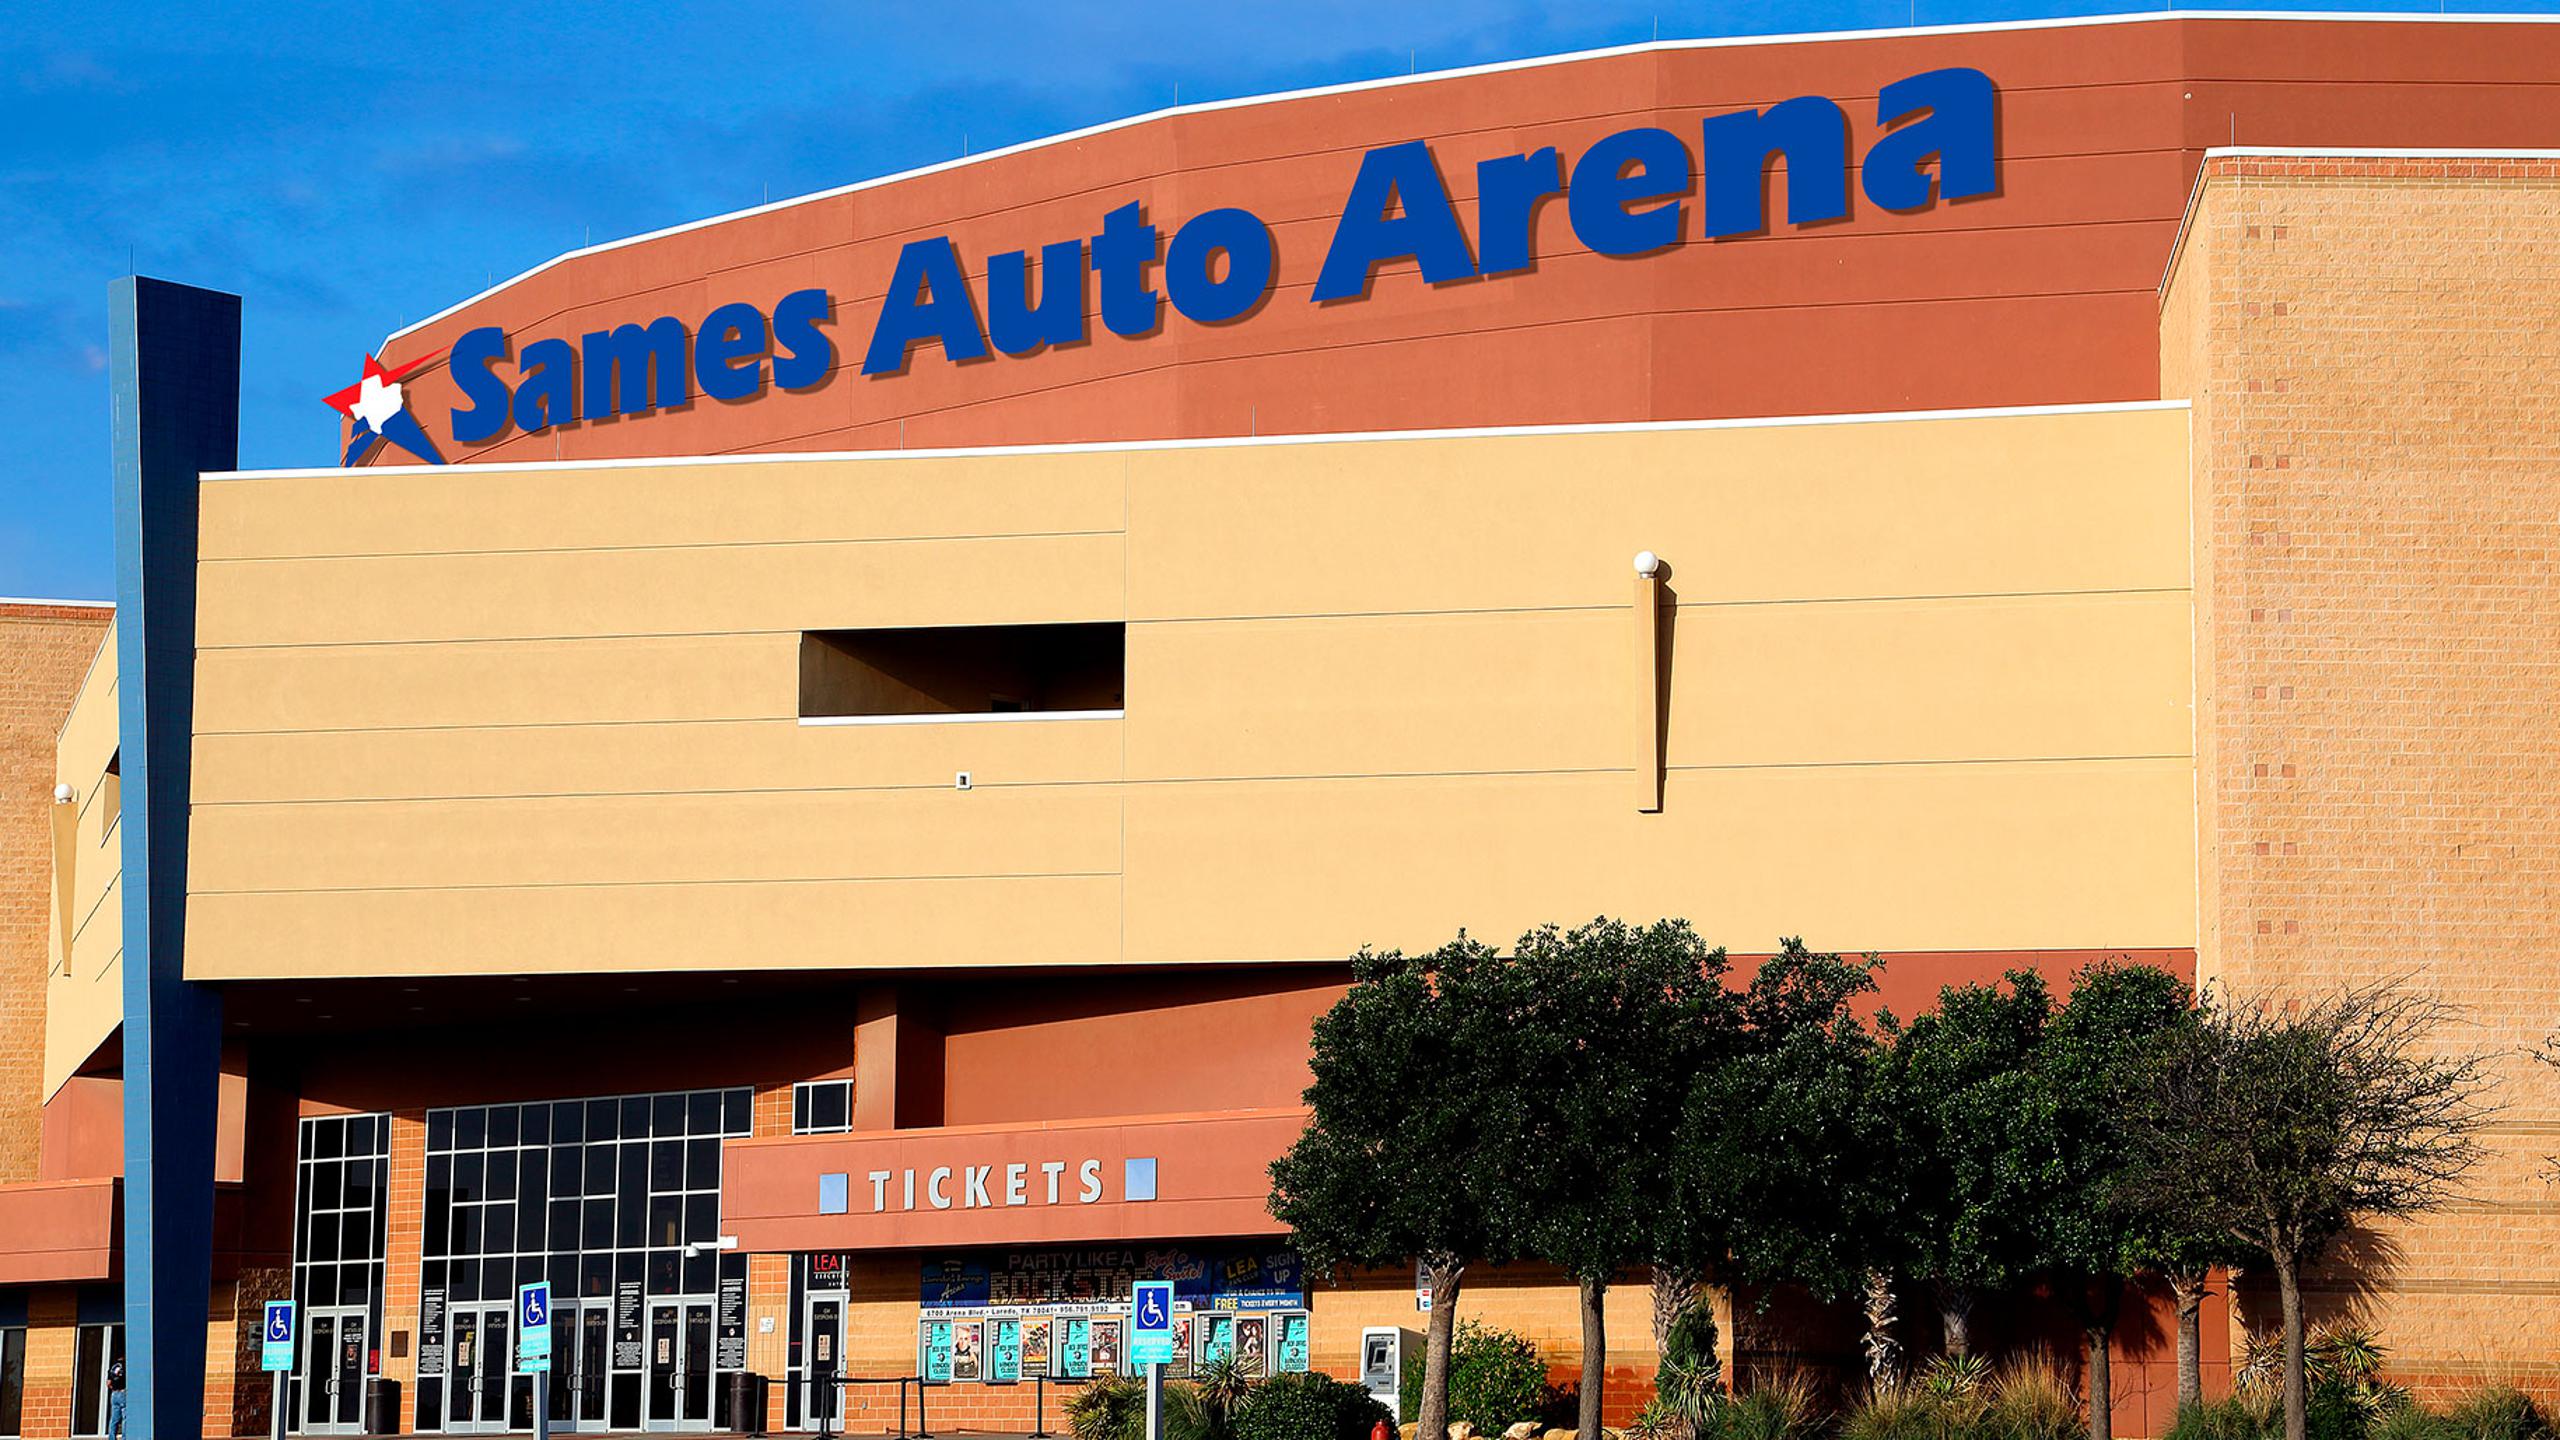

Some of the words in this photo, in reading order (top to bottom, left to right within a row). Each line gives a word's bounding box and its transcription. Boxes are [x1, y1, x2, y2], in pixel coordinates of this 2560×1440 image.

[450, 289, 831, 442] Sames
[862, 200, 1273, 375] Auto
[1311, 67, 1997, 302] Arena
[868, 1159, 1103, 1212] TICKETS
[814, 1254, 840, 1271] LEA
[1008, 1250, 1074, 1270] PARTY
[1077, 1250, 1115, 1268] LIKE
[1121, 1249, 1135, 1267] A
[1226, 1256, 1258, 1280] LEA
[1265, 1252, 1296, 1270] SIGN
[1274, 1269, 1291, 1284] UP
[1214, 1297, 1239, 1310] FREE
[946, 1309, 966, 1317] Arena
